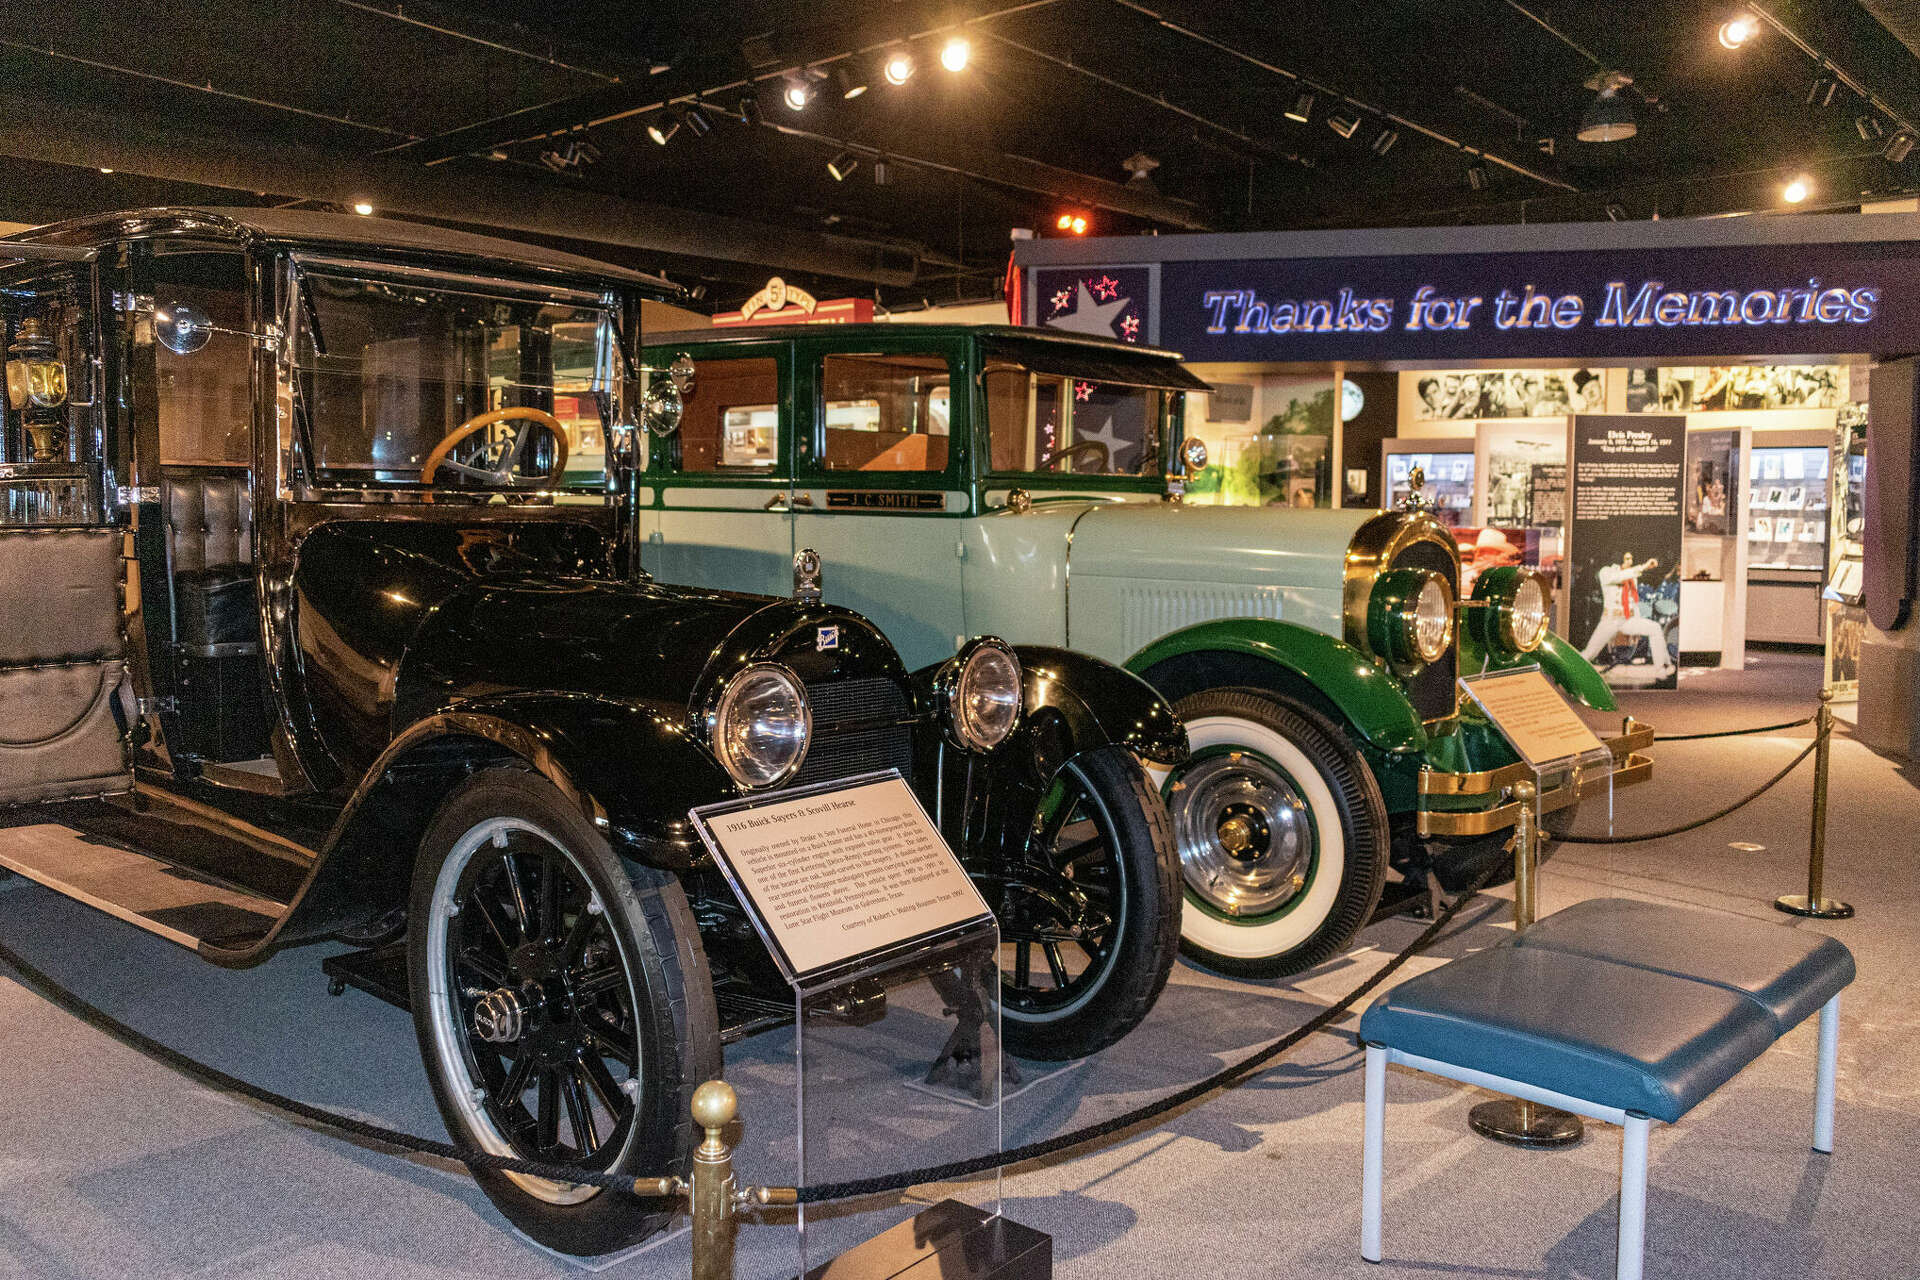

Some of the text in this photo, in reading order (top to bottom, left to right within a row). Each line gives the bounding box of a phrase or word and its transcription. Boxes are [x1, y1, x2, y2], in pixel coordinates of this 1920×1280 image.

[1203, 277, 1877, 334] Thanks for the Memories
[1607, 430, 1653, 440] Elvis Presley
[851, 494, 918, 507] J C SMITH
[726, 822, 746, 832] 1916
[747, 816, 770, 827] Buick
[770, 812, 797, 822] Sayers
[805, 803, 831, 815] Scovill
[830, 800, 855, 809] Hearse
[841, 920, 866, 930] Courtesy
